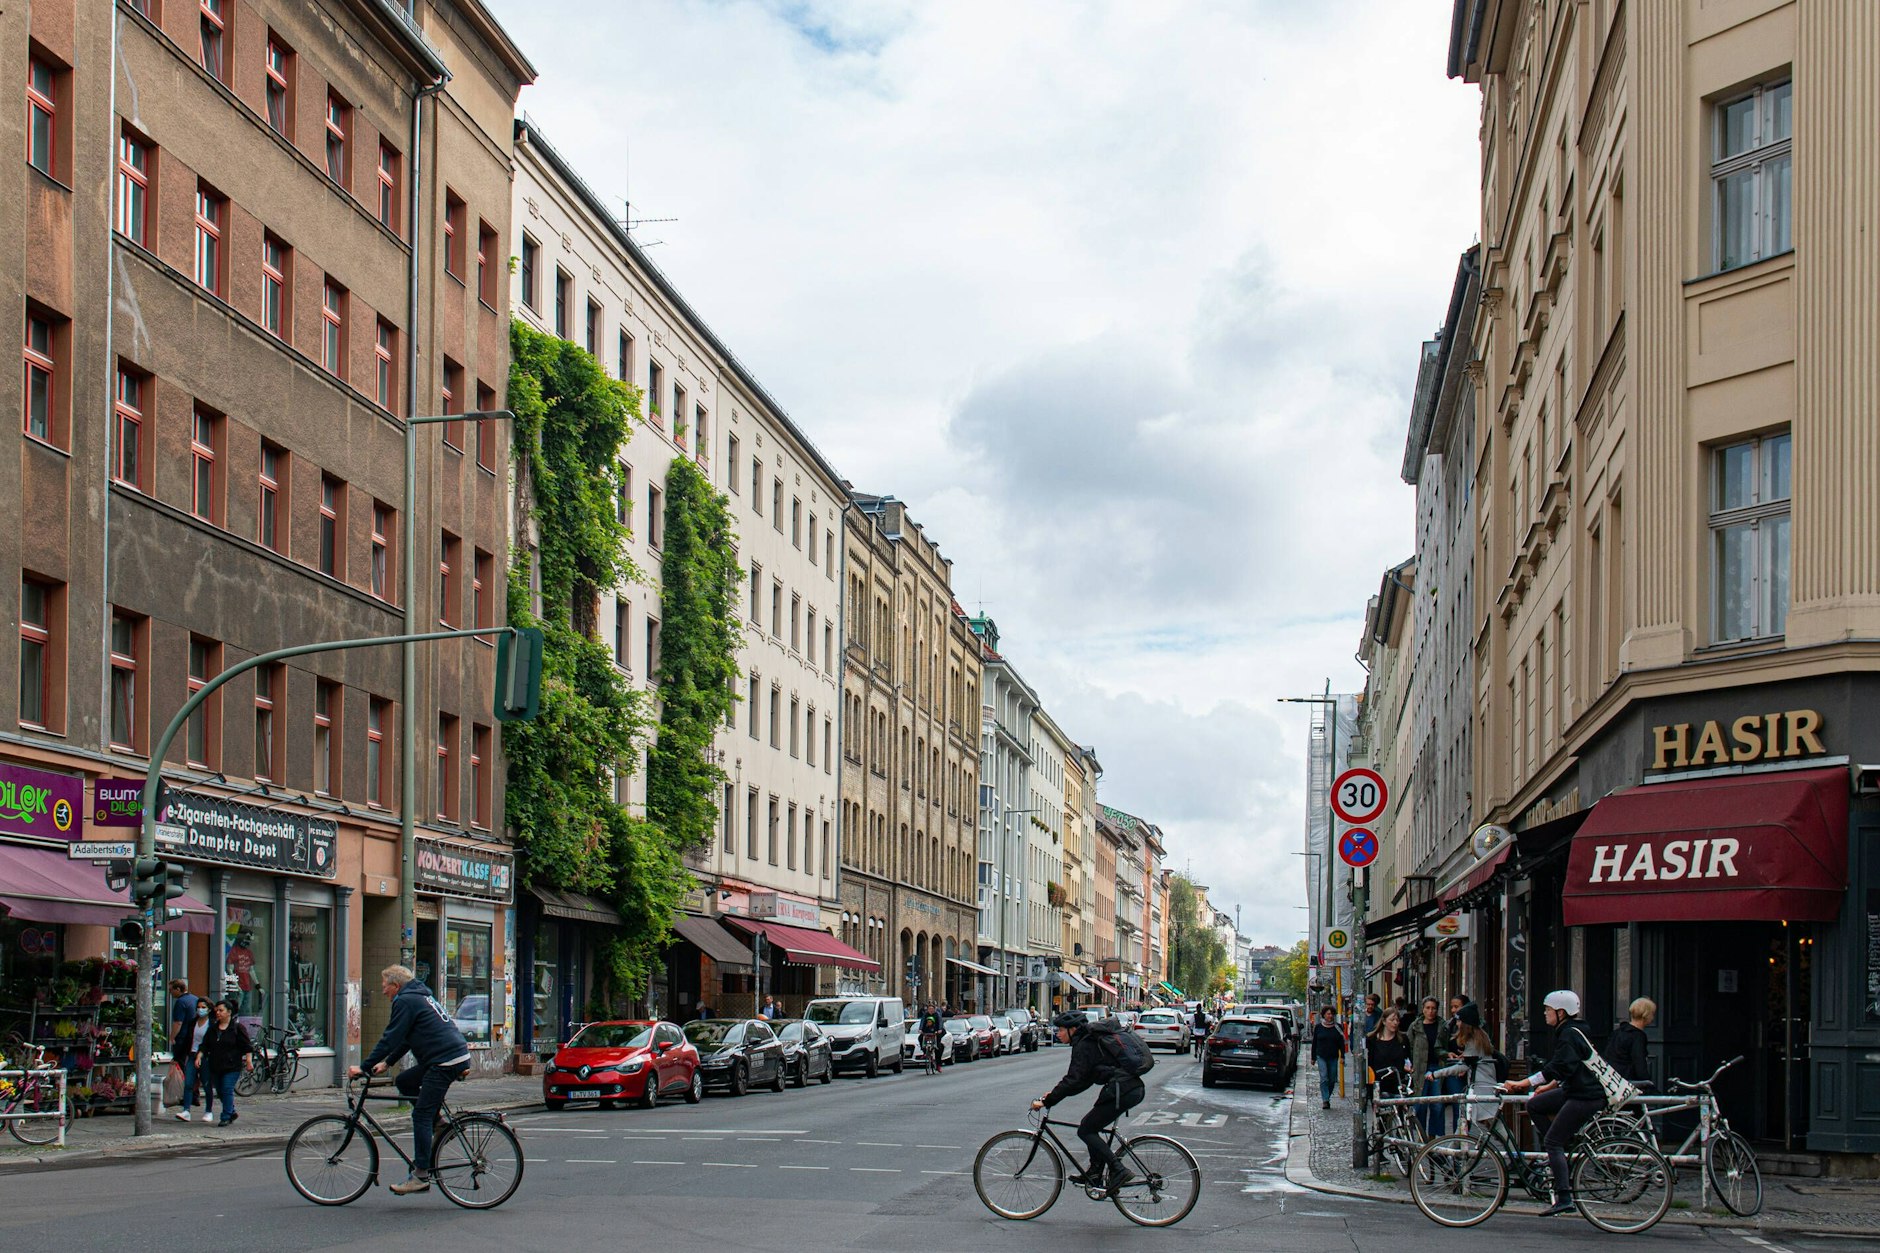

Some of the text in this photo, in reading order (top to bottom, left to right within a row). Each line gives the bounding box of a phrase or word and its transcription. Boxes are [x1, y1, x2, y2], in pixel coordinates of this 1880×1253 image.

[1652, 709, 1827, 769] HASIR
[1342, 783, 1375, 808] 30
[167, 803, 295, 840] e-Zigaretten-Fachgeschäft
[74, 844, 132, 856] Adalbertstße
[189, 828, 277, 859] Dampfer Depot
[1589, 838, 1740, 883] HASIR
